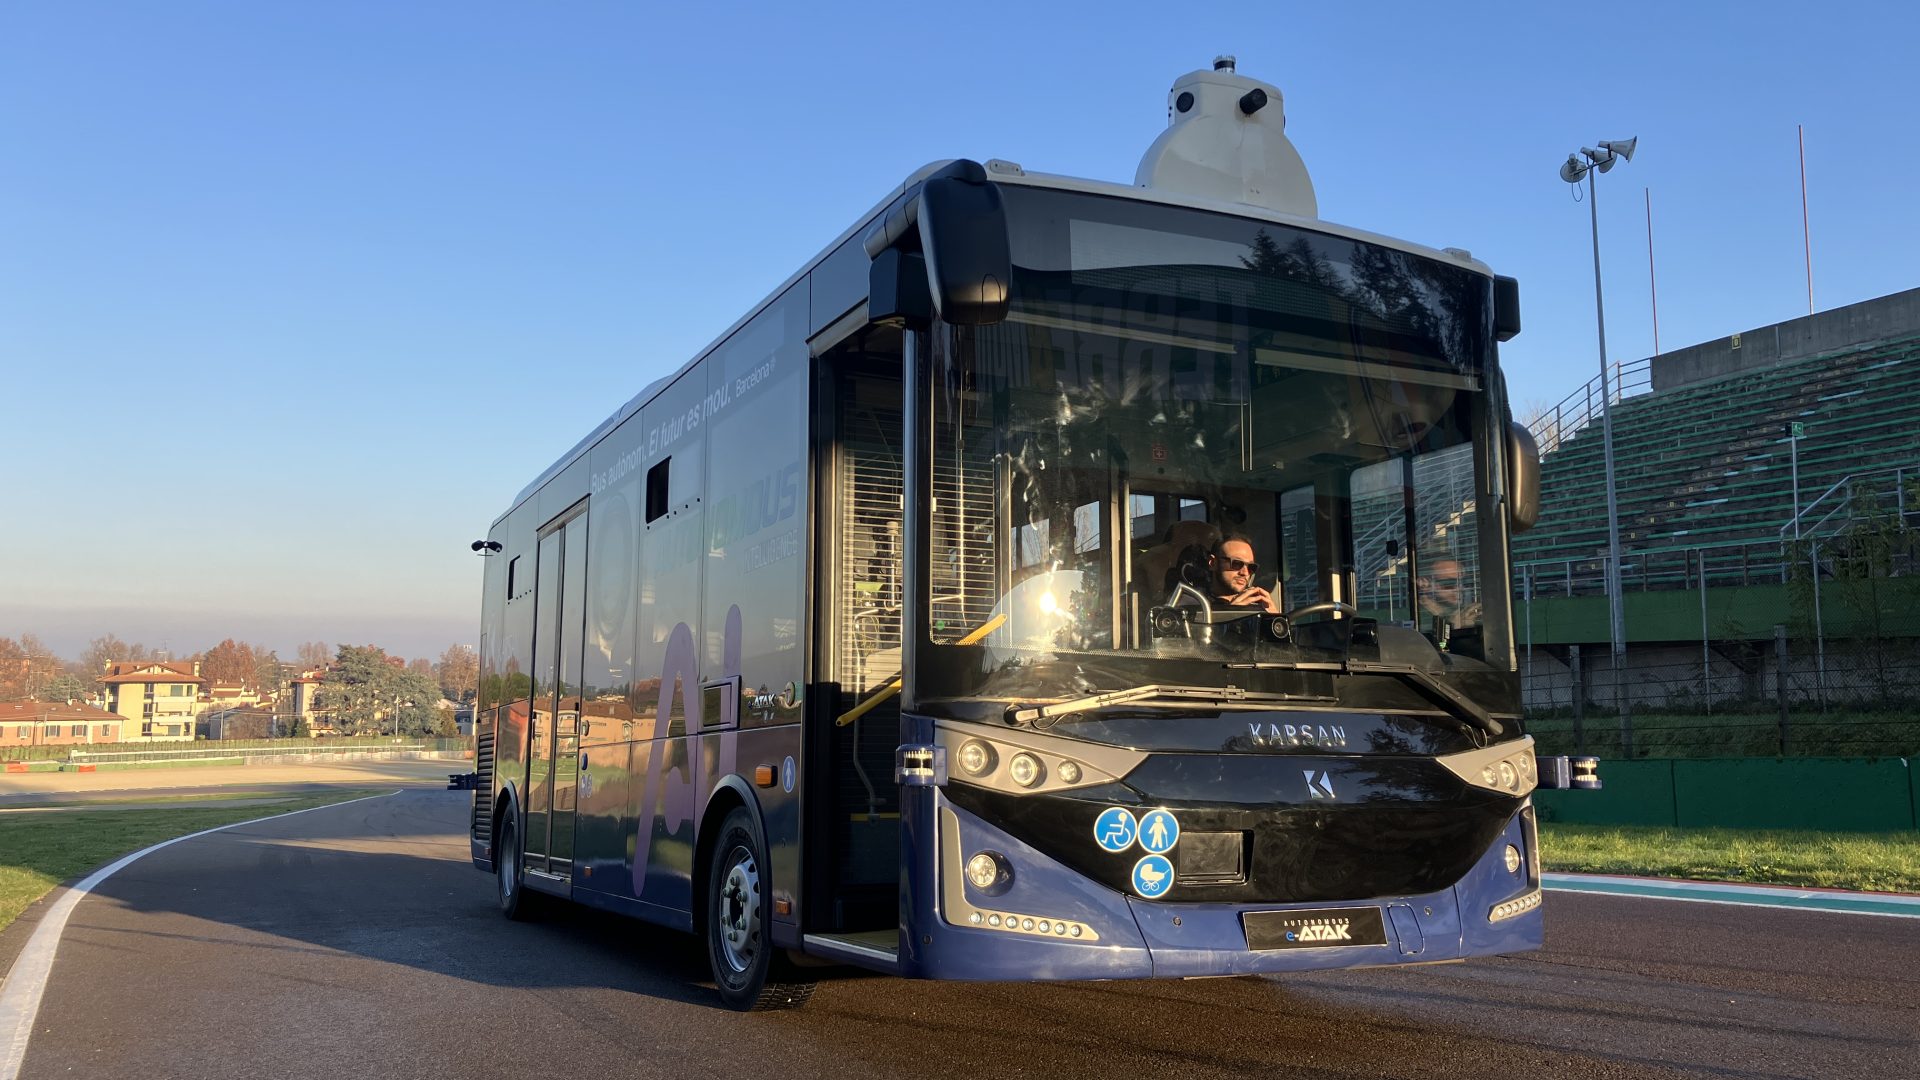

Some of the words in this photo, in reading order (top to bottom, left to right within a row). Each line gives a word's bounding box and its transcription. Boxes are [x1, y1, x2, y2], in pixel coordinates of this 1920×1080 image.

[735, 362, 770, 398] Barcelona
[591, 470, 607, 496] Bus
[648, 426, 660, 457] El
[660, 413, 686, 449] futur
[686, 402, 700, 431] es
[702, 383, 732, 422] mou.
[1248, 722, 1346, 747] KARSAN
[1284, 918, 1350, 927] AUTONOMOUS
[1285, 924, 1352, 942] e-ATAK
